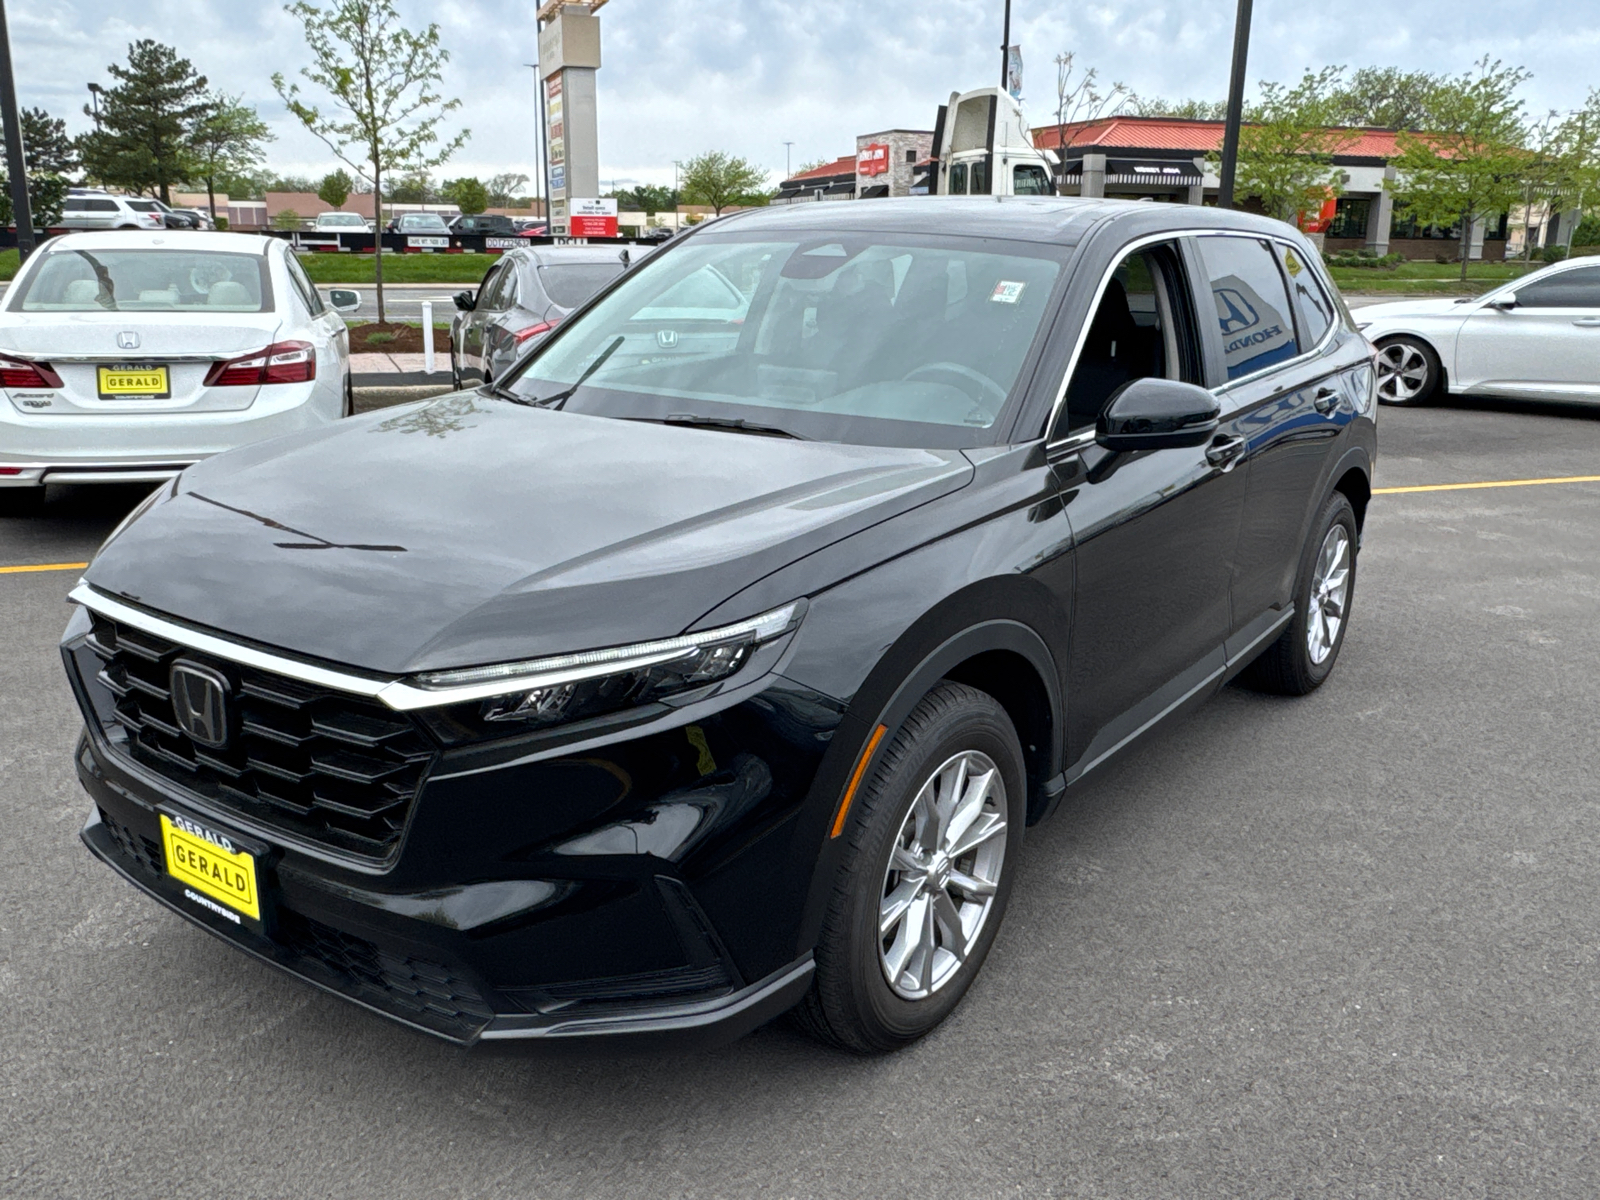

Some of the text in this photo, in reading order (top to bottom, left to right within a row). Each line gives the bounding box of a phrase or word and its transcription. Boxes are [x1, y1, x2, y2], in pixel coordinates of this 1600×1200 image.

[109, 378, 159, 387] GERALD
[174, 816, 234, 853] GERALD
[175, 844, 246, 892] GERALD
[184, 888, 241, 924] COUNTRYSIDE
